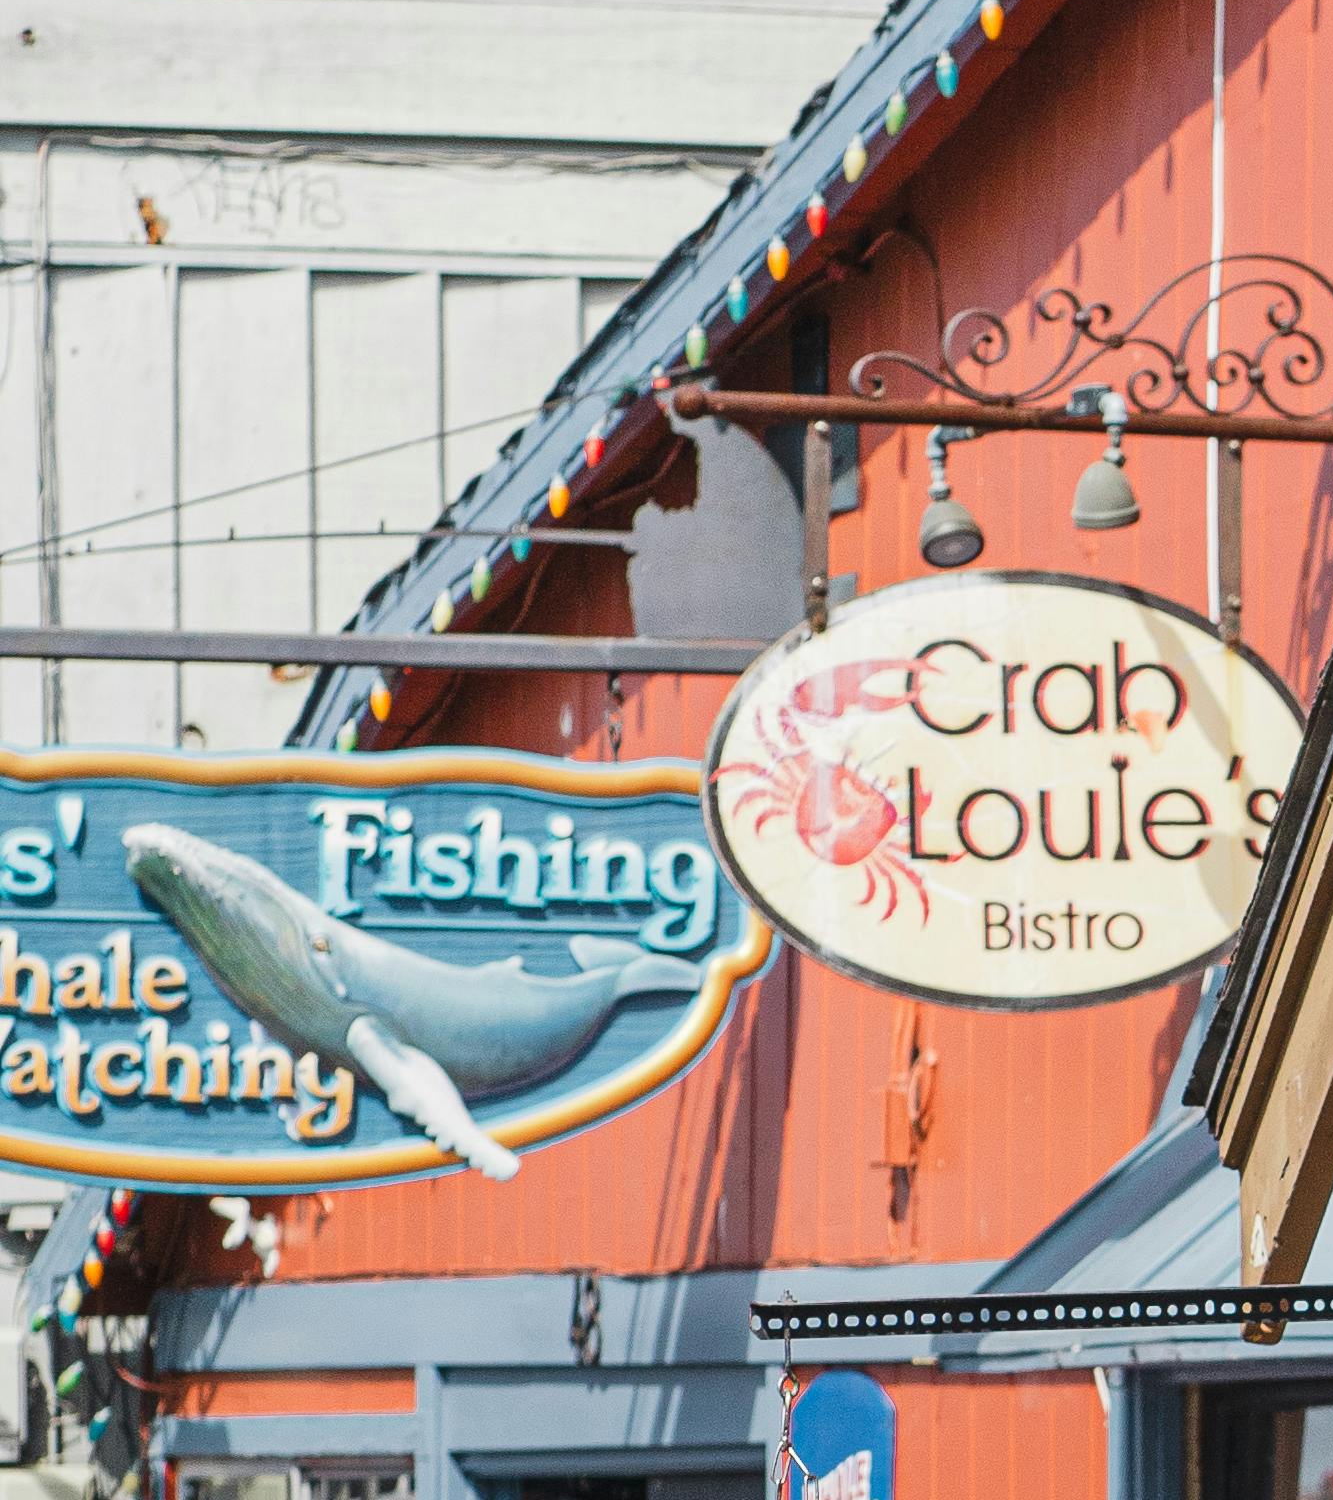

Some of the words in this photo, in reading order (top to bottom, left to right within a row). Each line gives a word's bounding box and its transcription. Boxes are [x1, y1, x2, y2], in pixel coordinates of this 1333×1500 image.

[906, 639, 1188, 735] Crab
[309, 799, 718, 952] Fishing
[984, 901, 1145, 951] Bistro
[0, 1017, 355, 1140] atching
